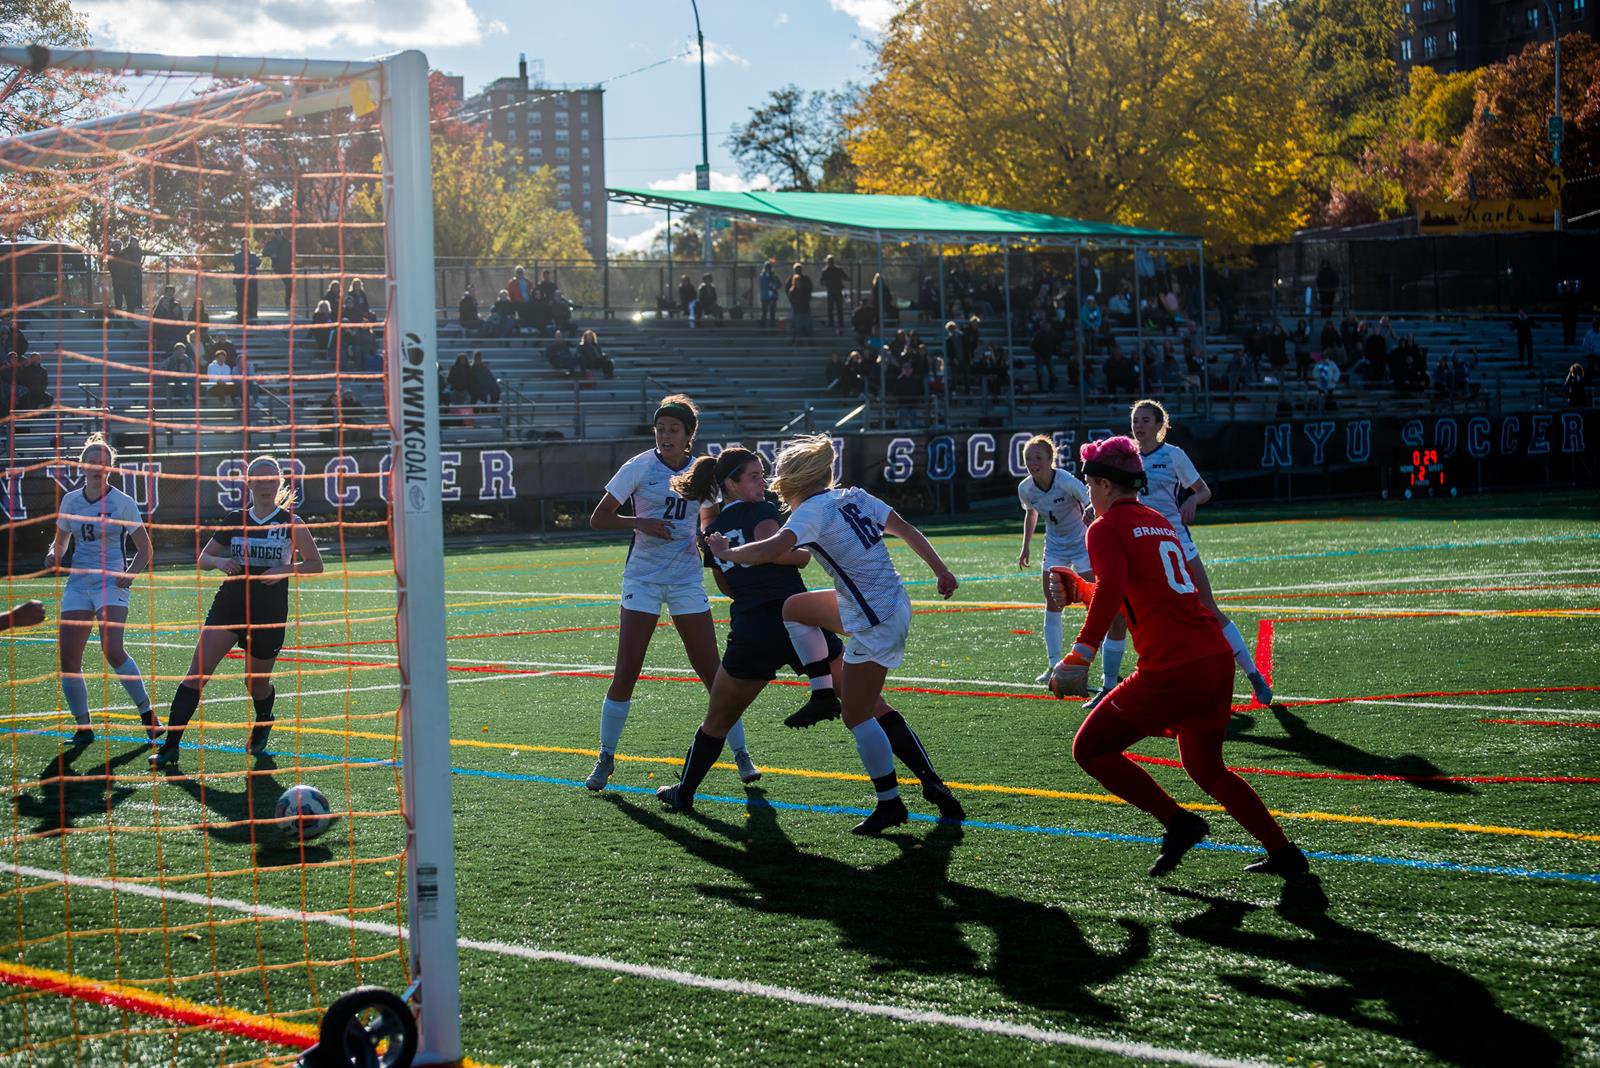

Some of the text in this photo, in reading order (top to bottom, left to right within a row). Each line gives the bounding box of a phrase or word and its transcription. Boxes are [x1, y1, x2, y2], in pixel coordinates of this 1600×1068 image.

[1261, 412, 1585, 466] NYU SOCCER
[663, 496, 688, 520] 20
[838, 502, 882, 550] 16
[1049, 510, 1058, 525] 4
[80, 523, 96, 542] 13
[1158, 540, 1195, 594] 0
